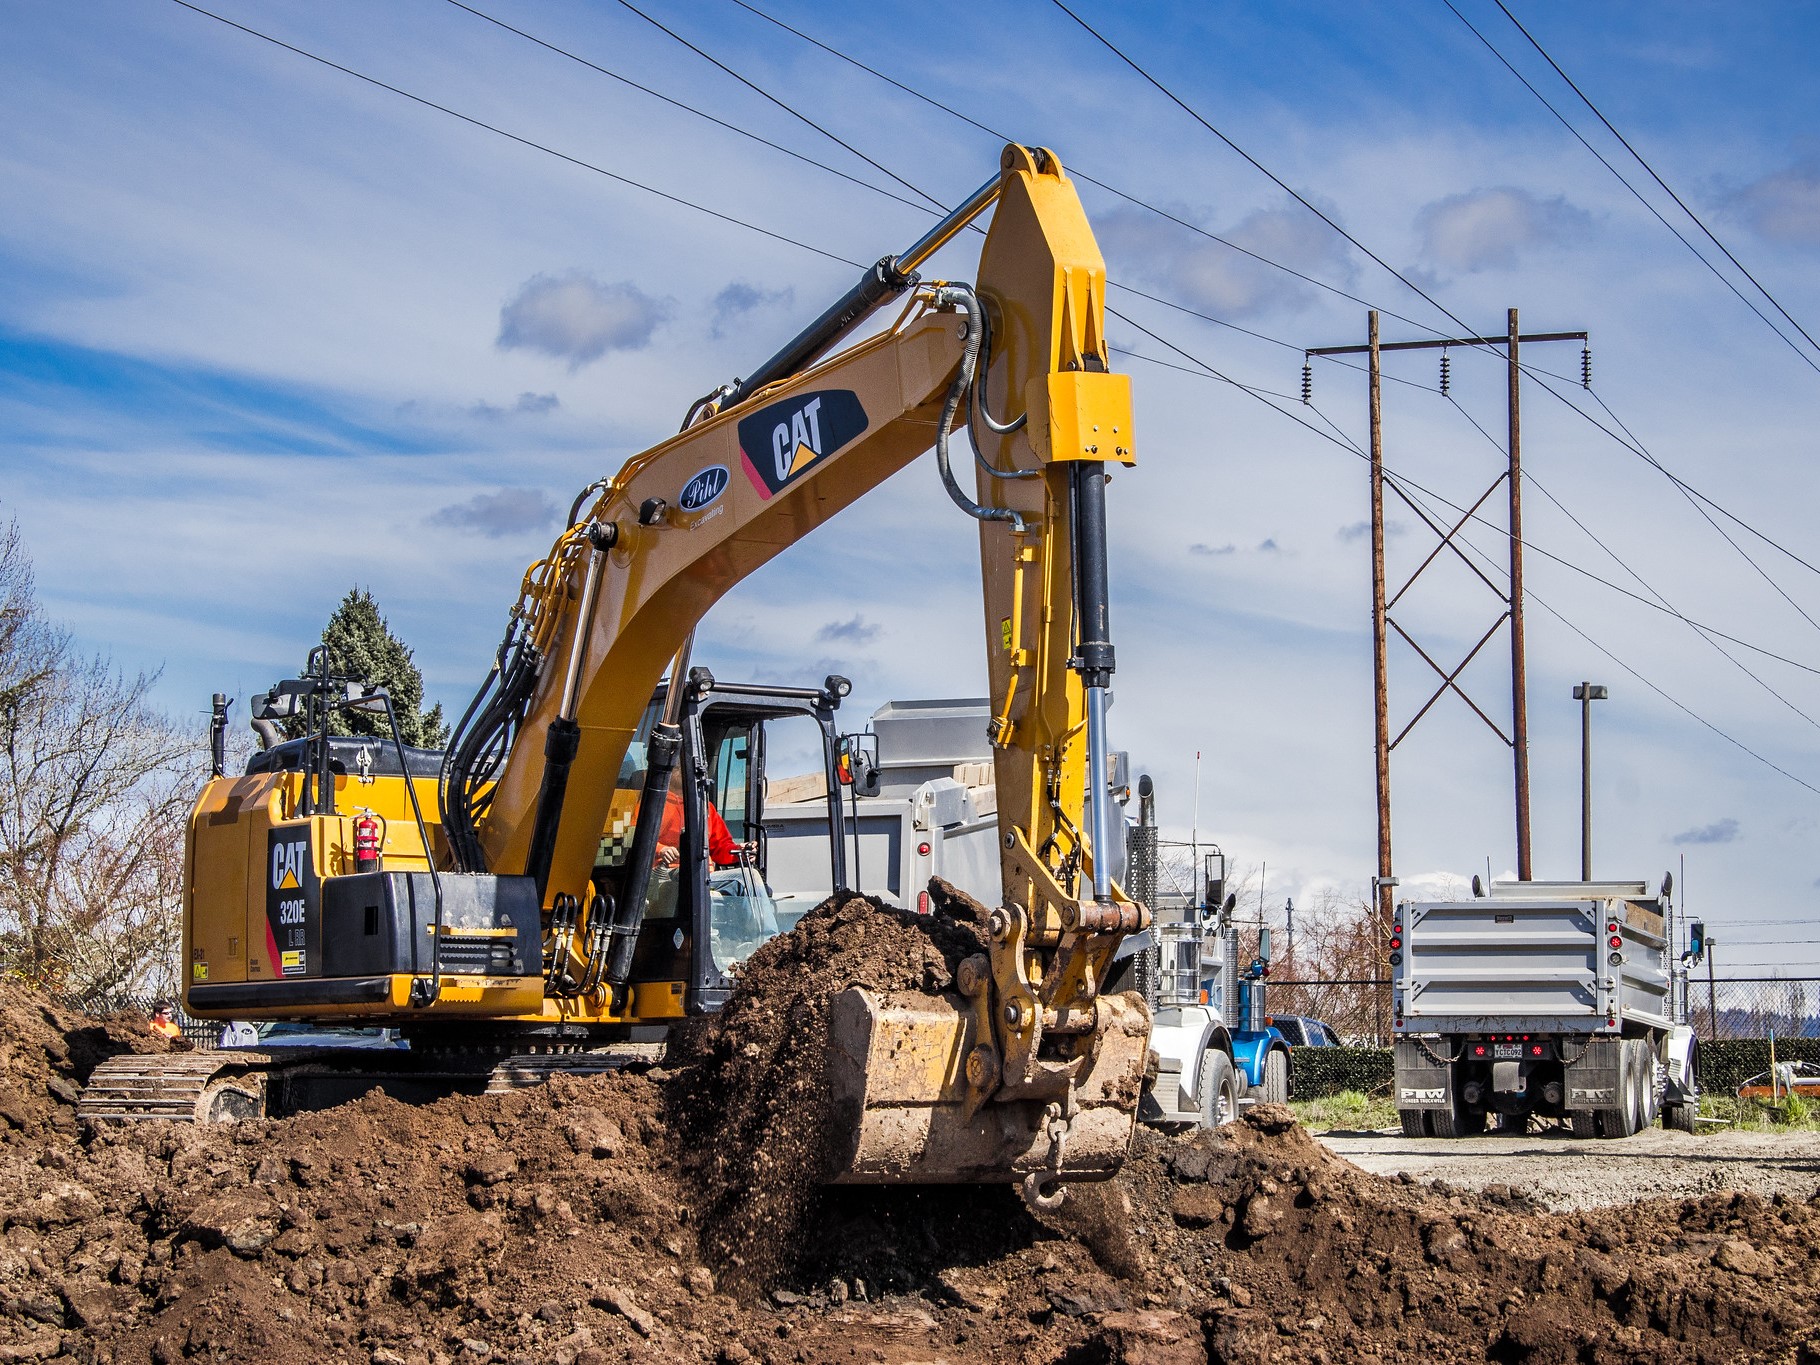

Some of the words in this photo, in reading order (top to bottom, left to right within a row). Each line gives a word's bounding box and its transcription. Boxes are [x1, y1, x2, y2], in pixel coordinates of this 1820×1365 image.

[772, 396, 822, 481] CAT
[687, 469, 721, 508] Pihl
[272, 841, 307, 890] CAT
[280, 899, 305, 924] 320E
